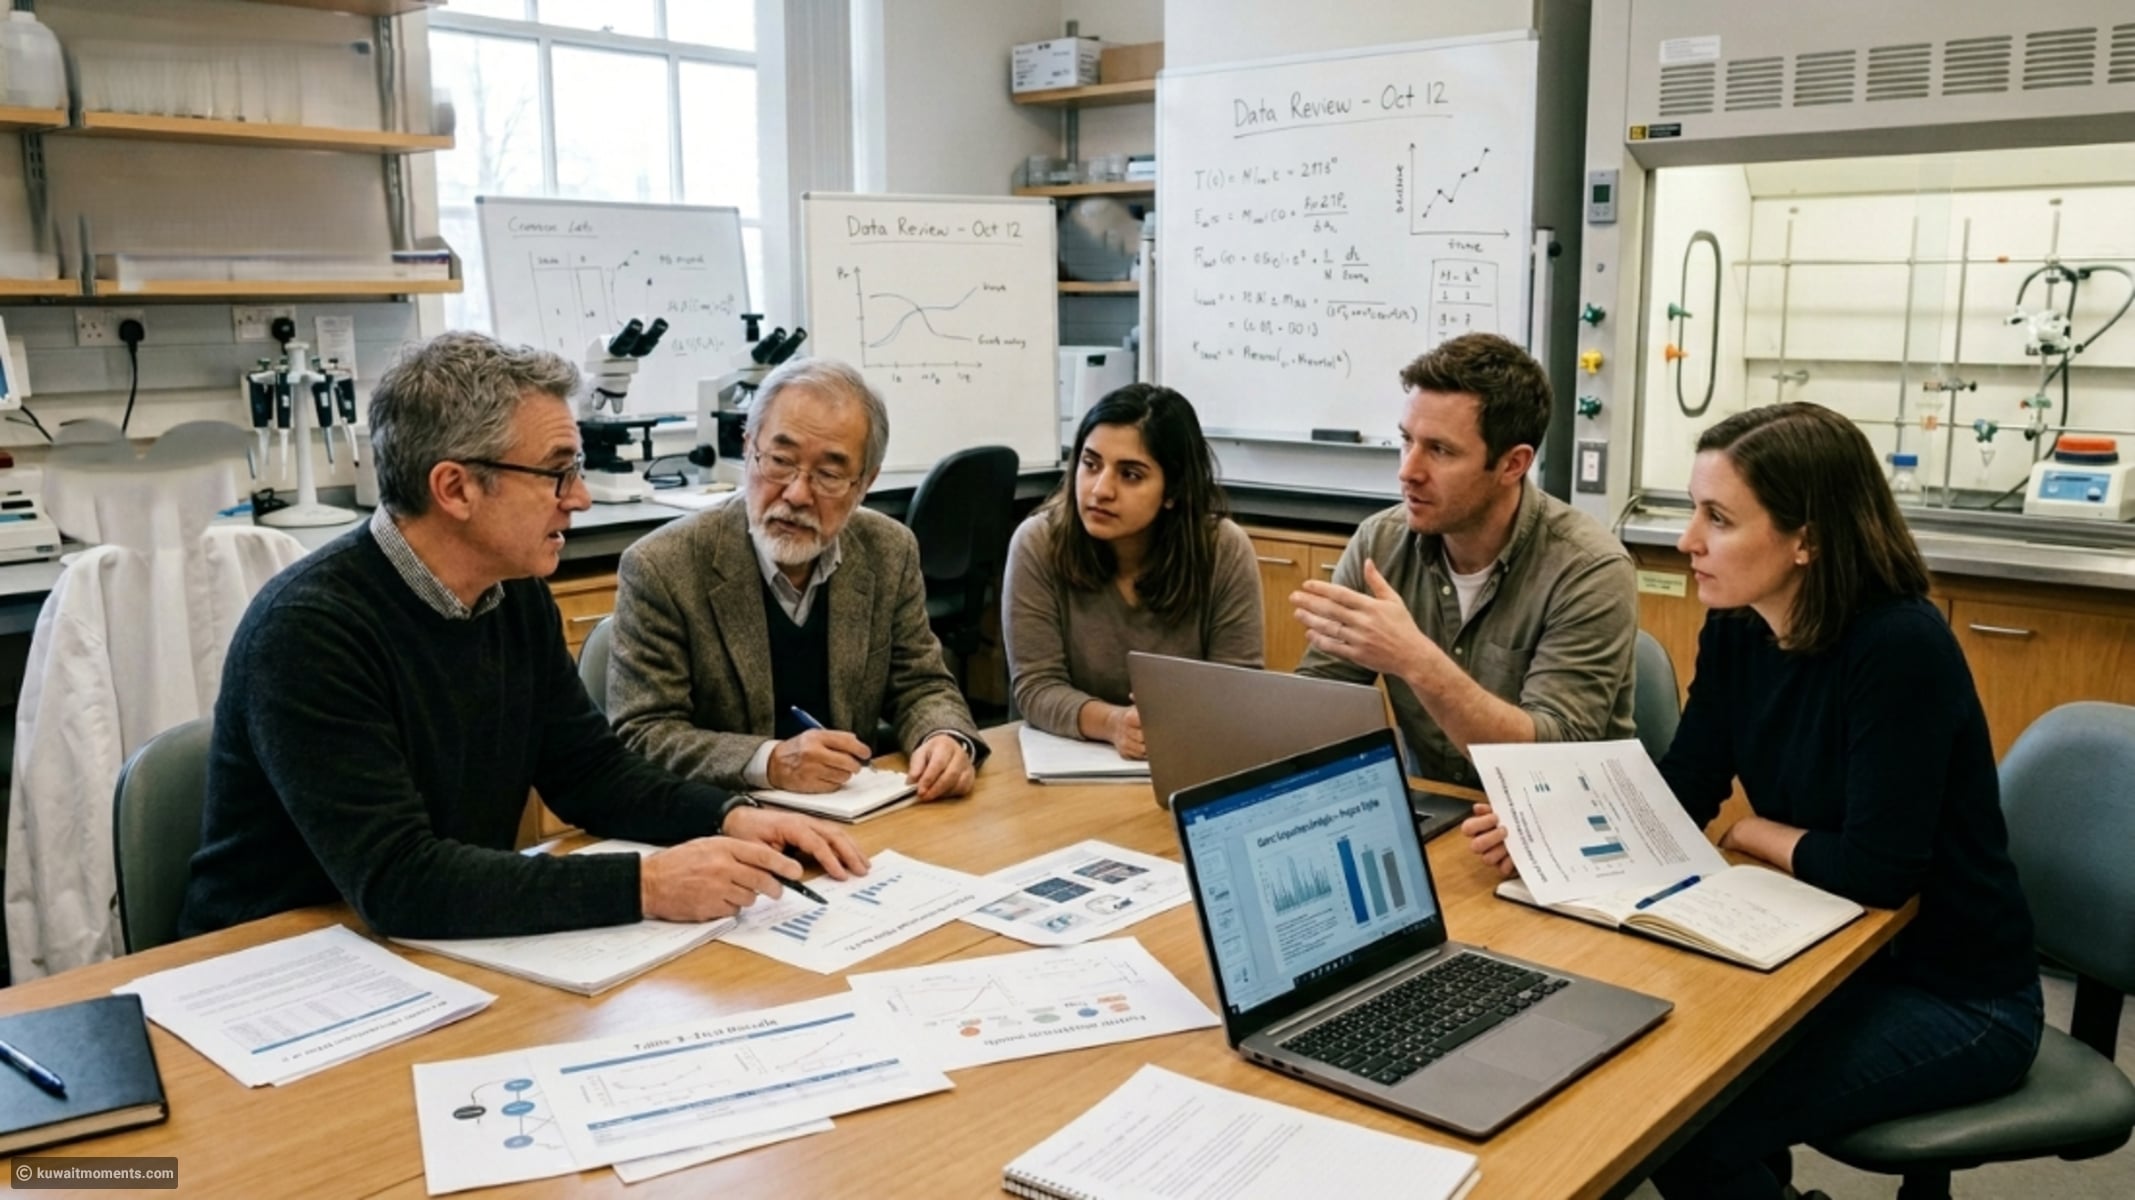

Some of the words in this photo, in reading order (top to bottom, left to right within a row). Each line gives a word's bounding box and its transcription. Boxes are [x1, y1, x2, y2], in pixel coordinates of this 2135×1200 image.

[1234, 98, 1277, 127] Data
[1290, 91, 1351, 118] Review
[1380, 84, 1415, 110] Oct
[1426, 81, 1449, 105] 12
[847, 215, 888, 237] Data
[898, 216, 949, 237] Review
[972, 220, 999, 237] Oct
[1006, 221, 1023, 238] 12
